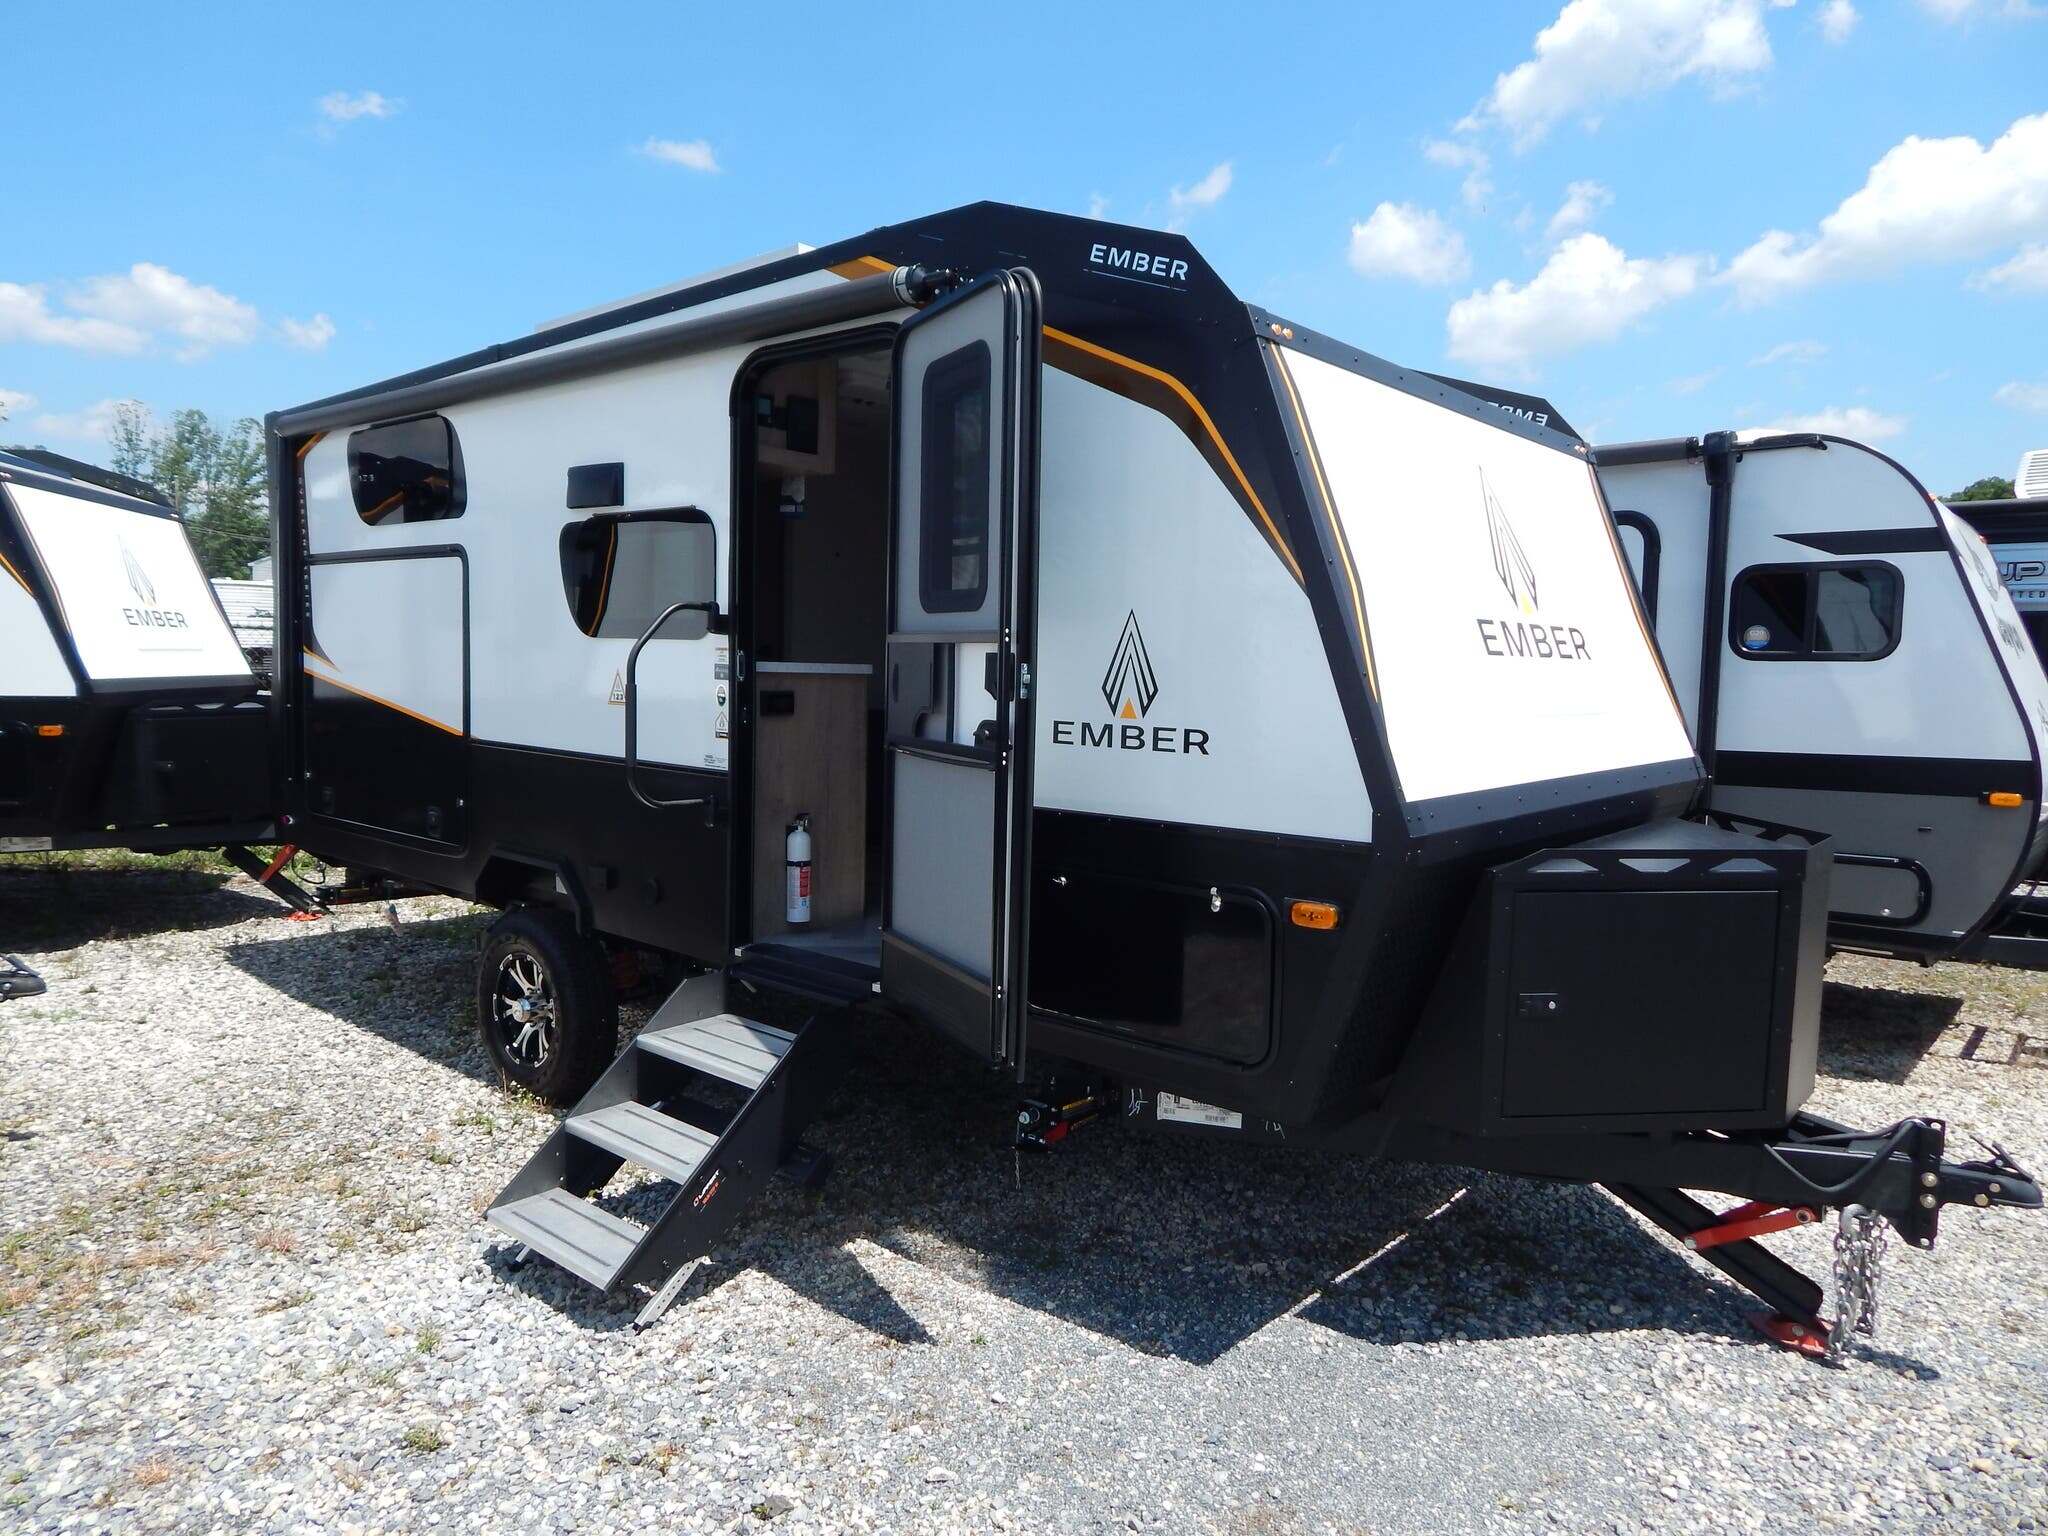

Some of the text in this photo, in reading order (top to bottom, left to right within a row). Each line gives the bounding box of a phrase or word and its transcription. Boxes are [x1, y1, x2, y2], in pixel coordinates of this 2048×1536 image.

[1089, 243, 1189, 281] EMBER
[122, 608, 189, 629] EMBER
[1476, 618, 1592, 660] EMBER
[1052, 719, 1210, 756] EMBER
